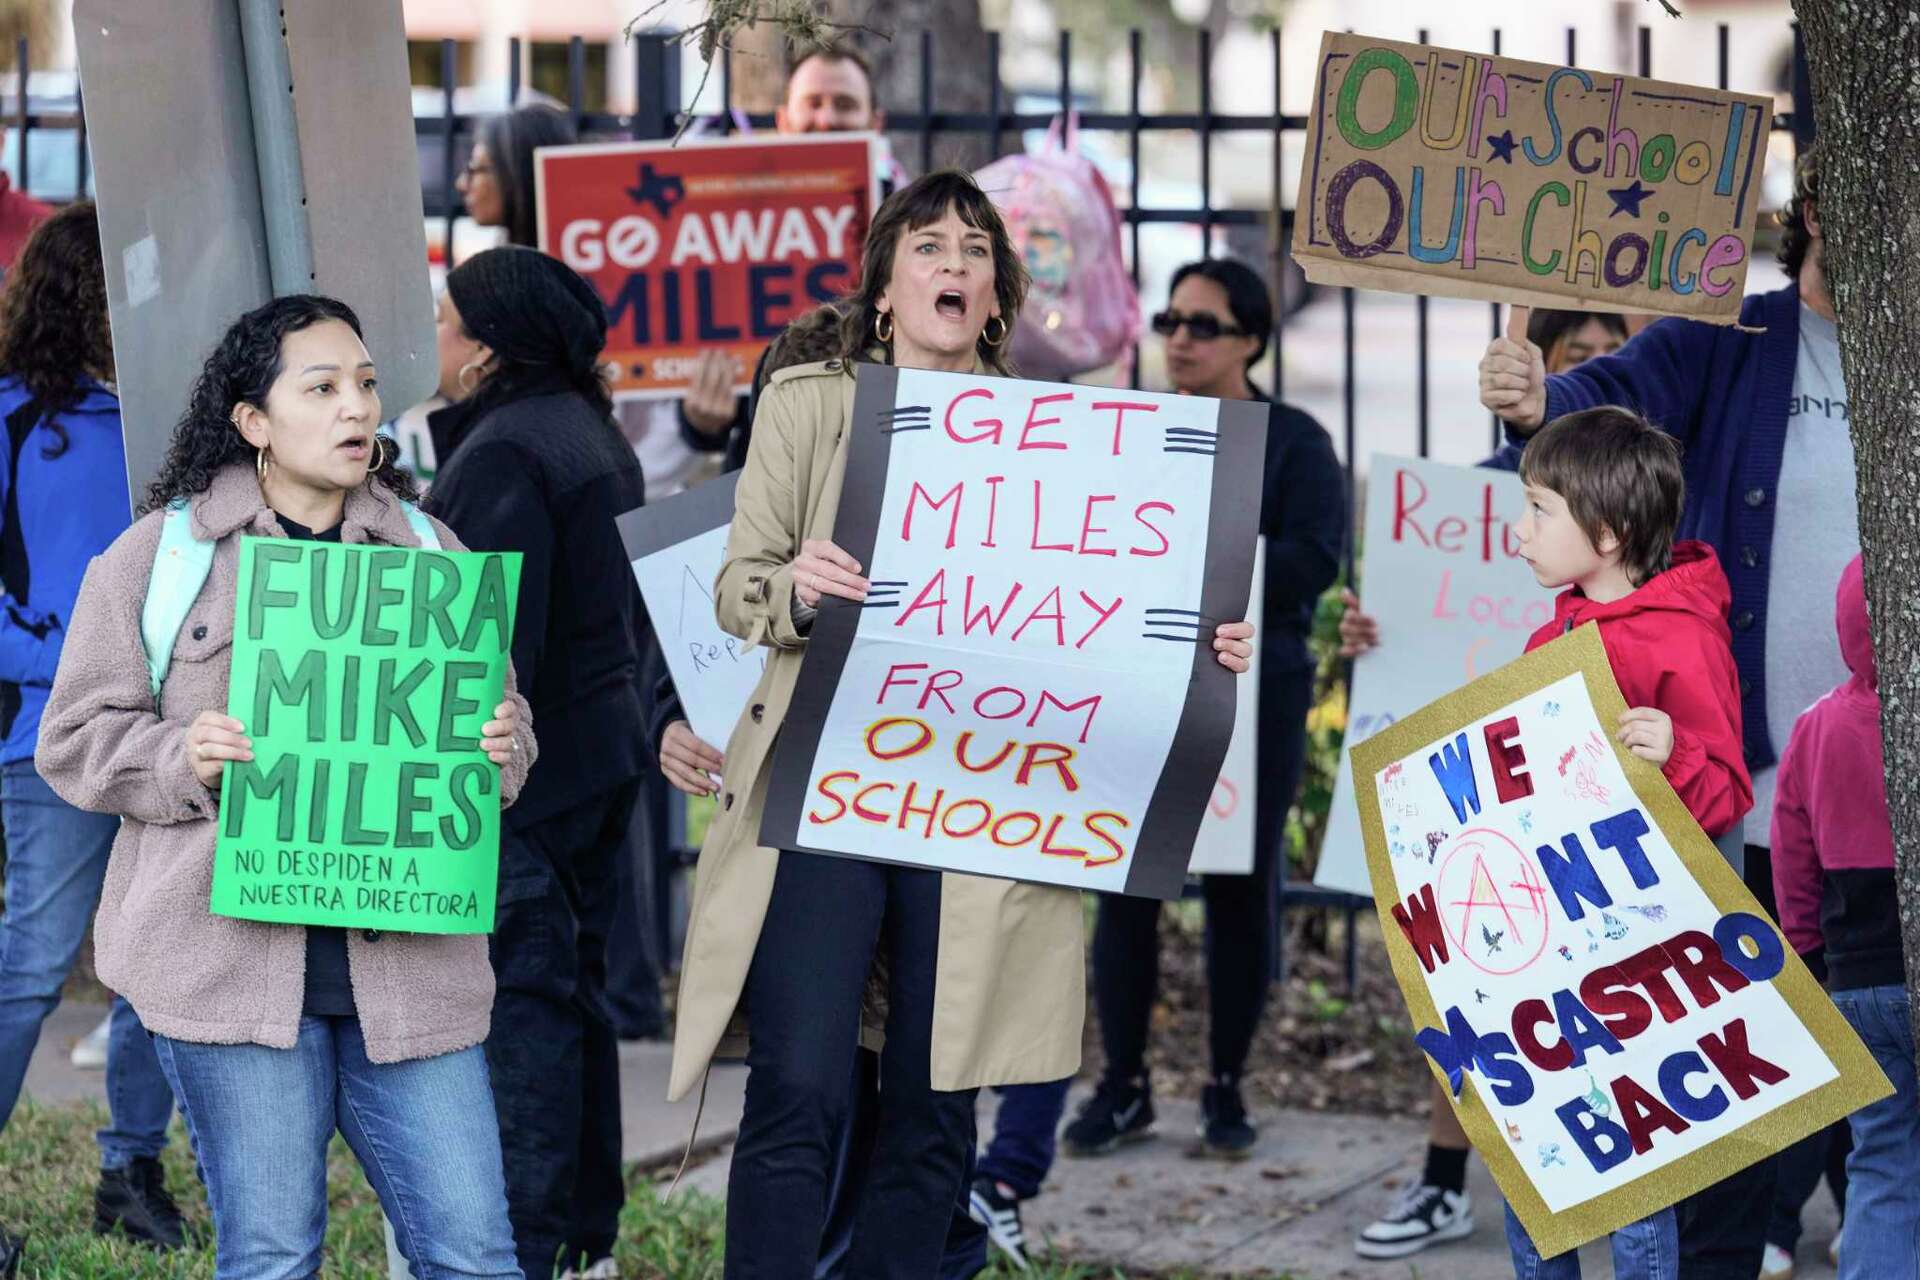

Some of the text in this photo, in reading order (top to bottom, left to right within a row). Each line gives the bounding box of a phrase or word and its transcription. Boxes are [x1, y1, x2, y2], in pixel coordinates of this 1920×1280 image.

[1522, 67, 1747, 196] School
[561, 204, 857, 271] GO AWAY
[1522, 180, 1746, 297] Choice
[944, 388, 1159, 456] GET
[901, 476, 1176, 557] MILES
[248, 543, 510, 654] FUERA
[894, 568, 1123, 649] AWAY
[252, 649, 489, 753] MIKE
[877, 663, 1102, 743] FROM
[865, 716, 1079, 792] OUR
[1429, 715, 1535, 825] WE
[225, 753, 492, 851] MILES
[809, 770, 1131, 868] SCHOOLS
[235, 850, 420, 886] NO DESPIDEN A
[239, 884, 479, 919] NUESTRA DIRECTORA
[1555, 1017, 1790, 1173] BACK
